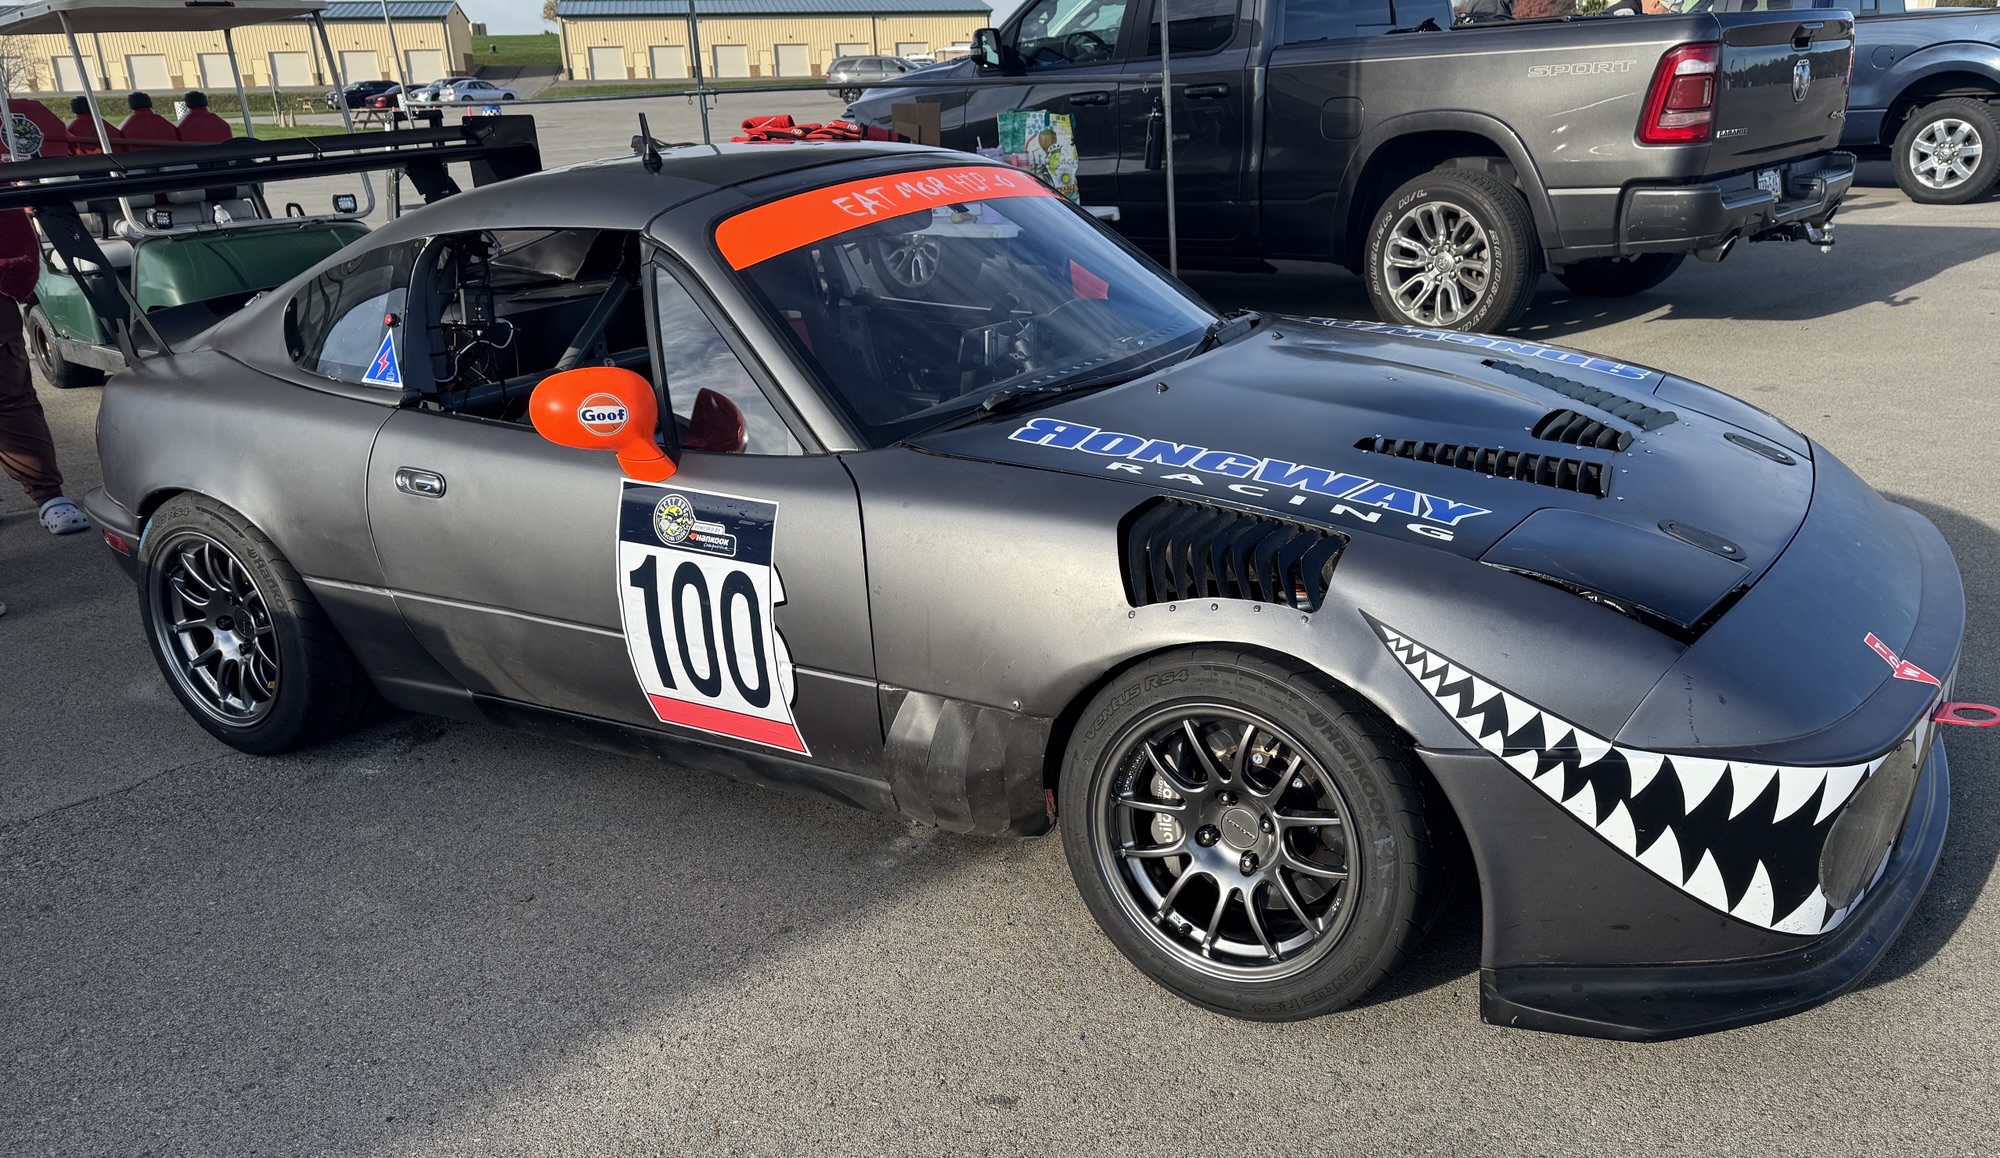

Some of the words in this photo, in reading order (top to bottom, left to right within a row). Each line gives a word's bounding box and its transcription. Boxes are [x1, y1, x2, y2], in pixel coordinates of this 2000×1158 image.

[1527, 60, 1637, 78] SPORT
[832, 187, 897, 216] EAT
[581, 409, 625, 421] Goof
[1106, 461, 1455, 542] RACING
[629, 554, 771, 709] 100
[1874, 642, 1921, 678] TOW
